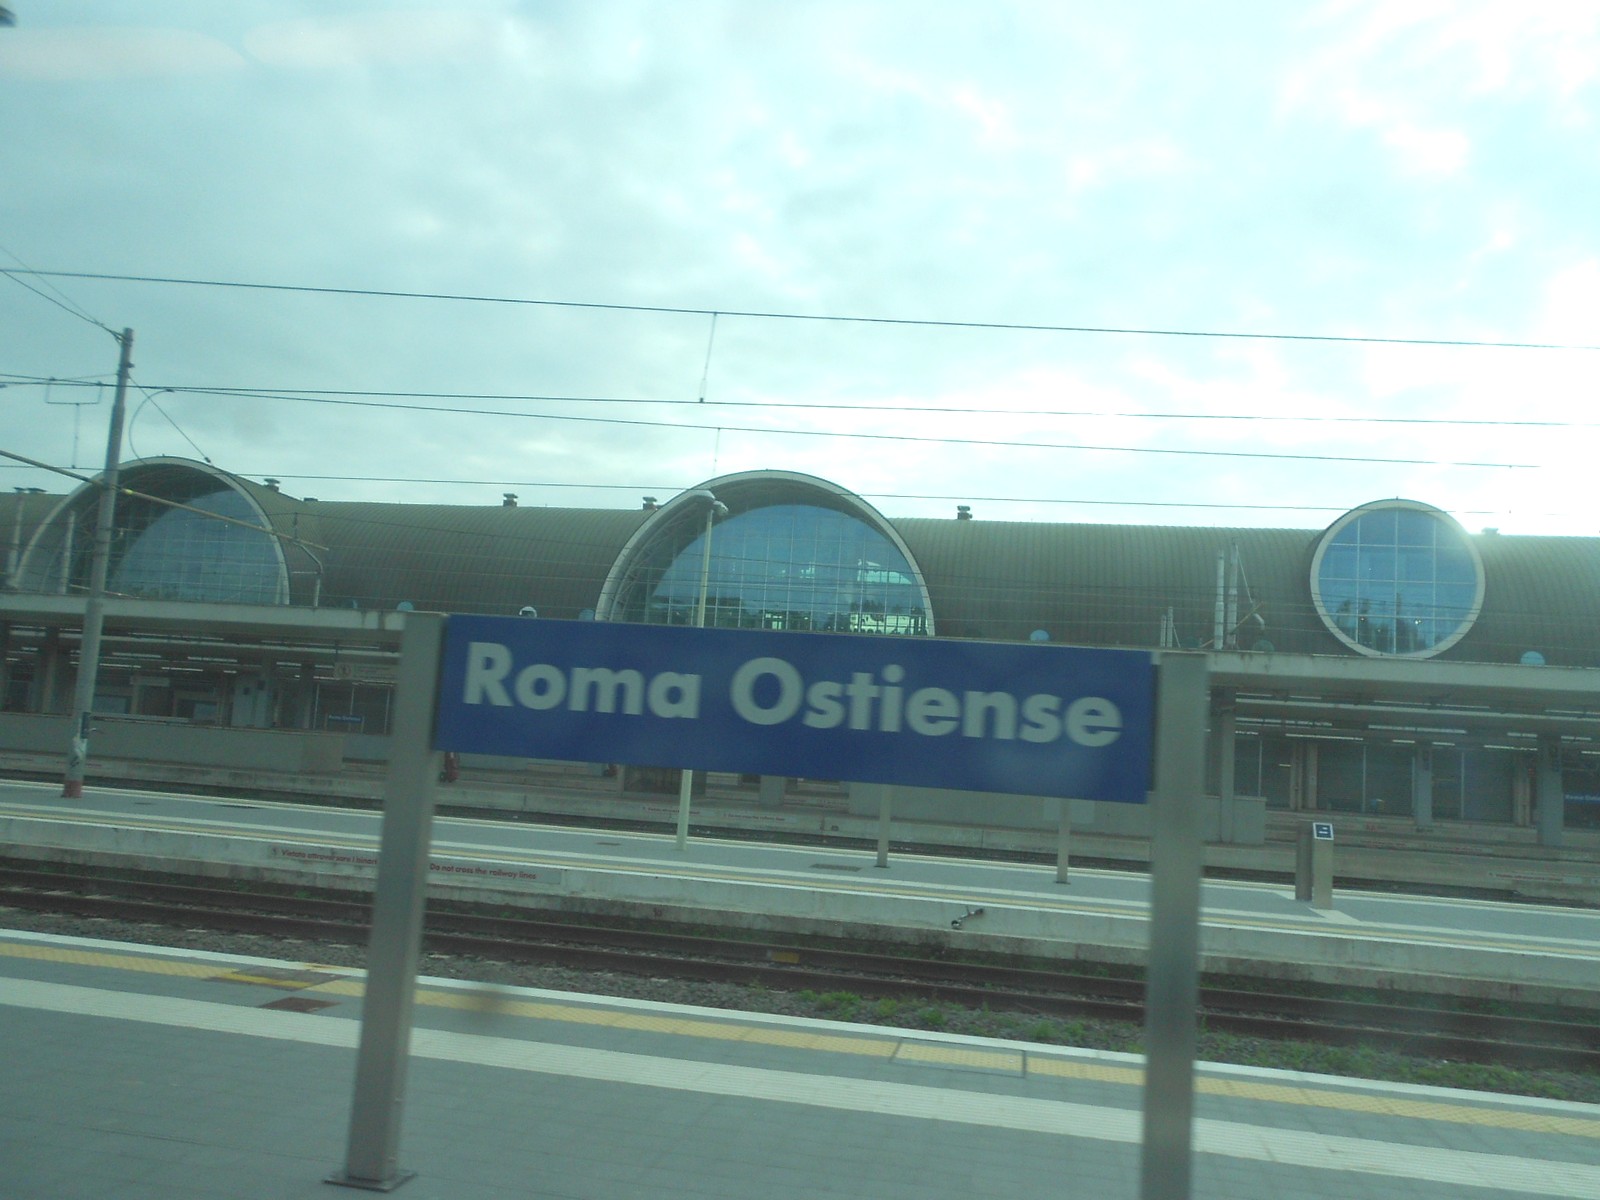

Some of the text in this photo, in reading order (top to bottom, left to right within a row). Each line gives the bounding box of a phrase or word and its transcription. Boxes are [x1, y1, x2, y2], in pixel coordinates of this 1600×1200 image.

[465, 641, 1122, 748] Roma Ostiense
[429, 863, 440, 871] Do
[475, 867, 487, 875] the
[489, 869, 517, 880] railway
